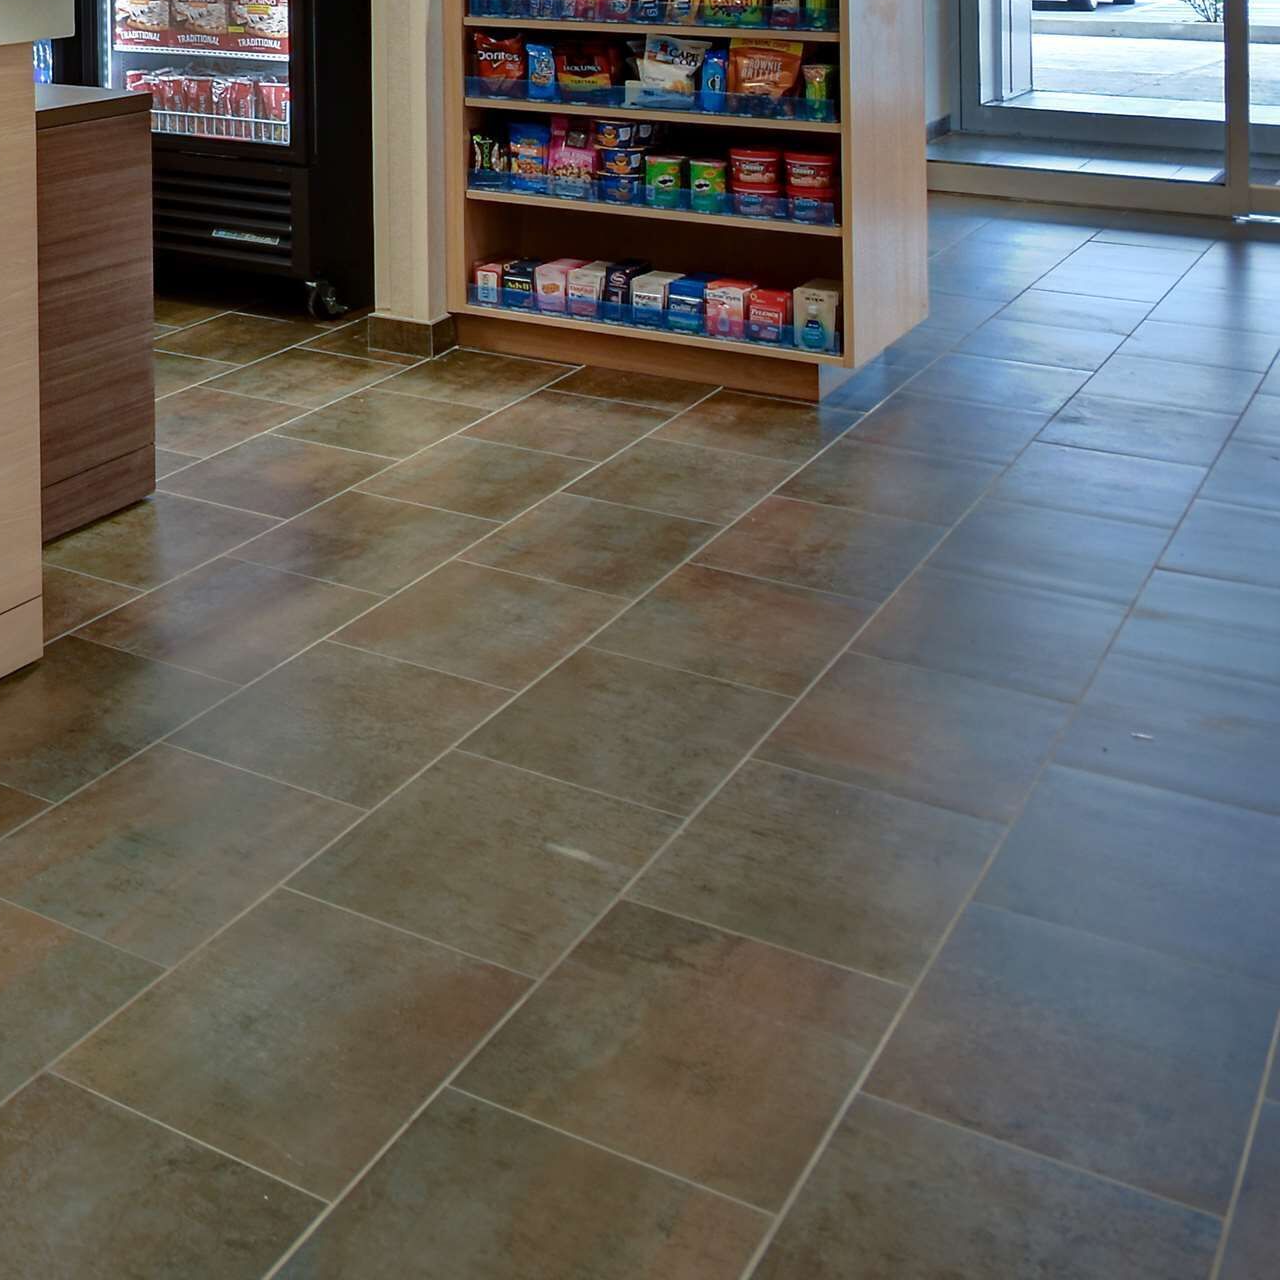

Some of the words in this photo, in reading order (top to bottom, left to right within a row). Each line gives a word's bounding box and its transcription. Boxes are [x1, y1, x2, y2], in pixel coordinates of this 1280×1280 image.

[119, 30, 161, 42] TRADITIONAL
[177, 33, 220, 46] TRADITIONAL
[238, 37, 282, 50] TRADITIONAL
[477, 50, 519, 62] Doritos
[670, 48, 700, 61] CAPE
[672, 57, 697, 67] COD
